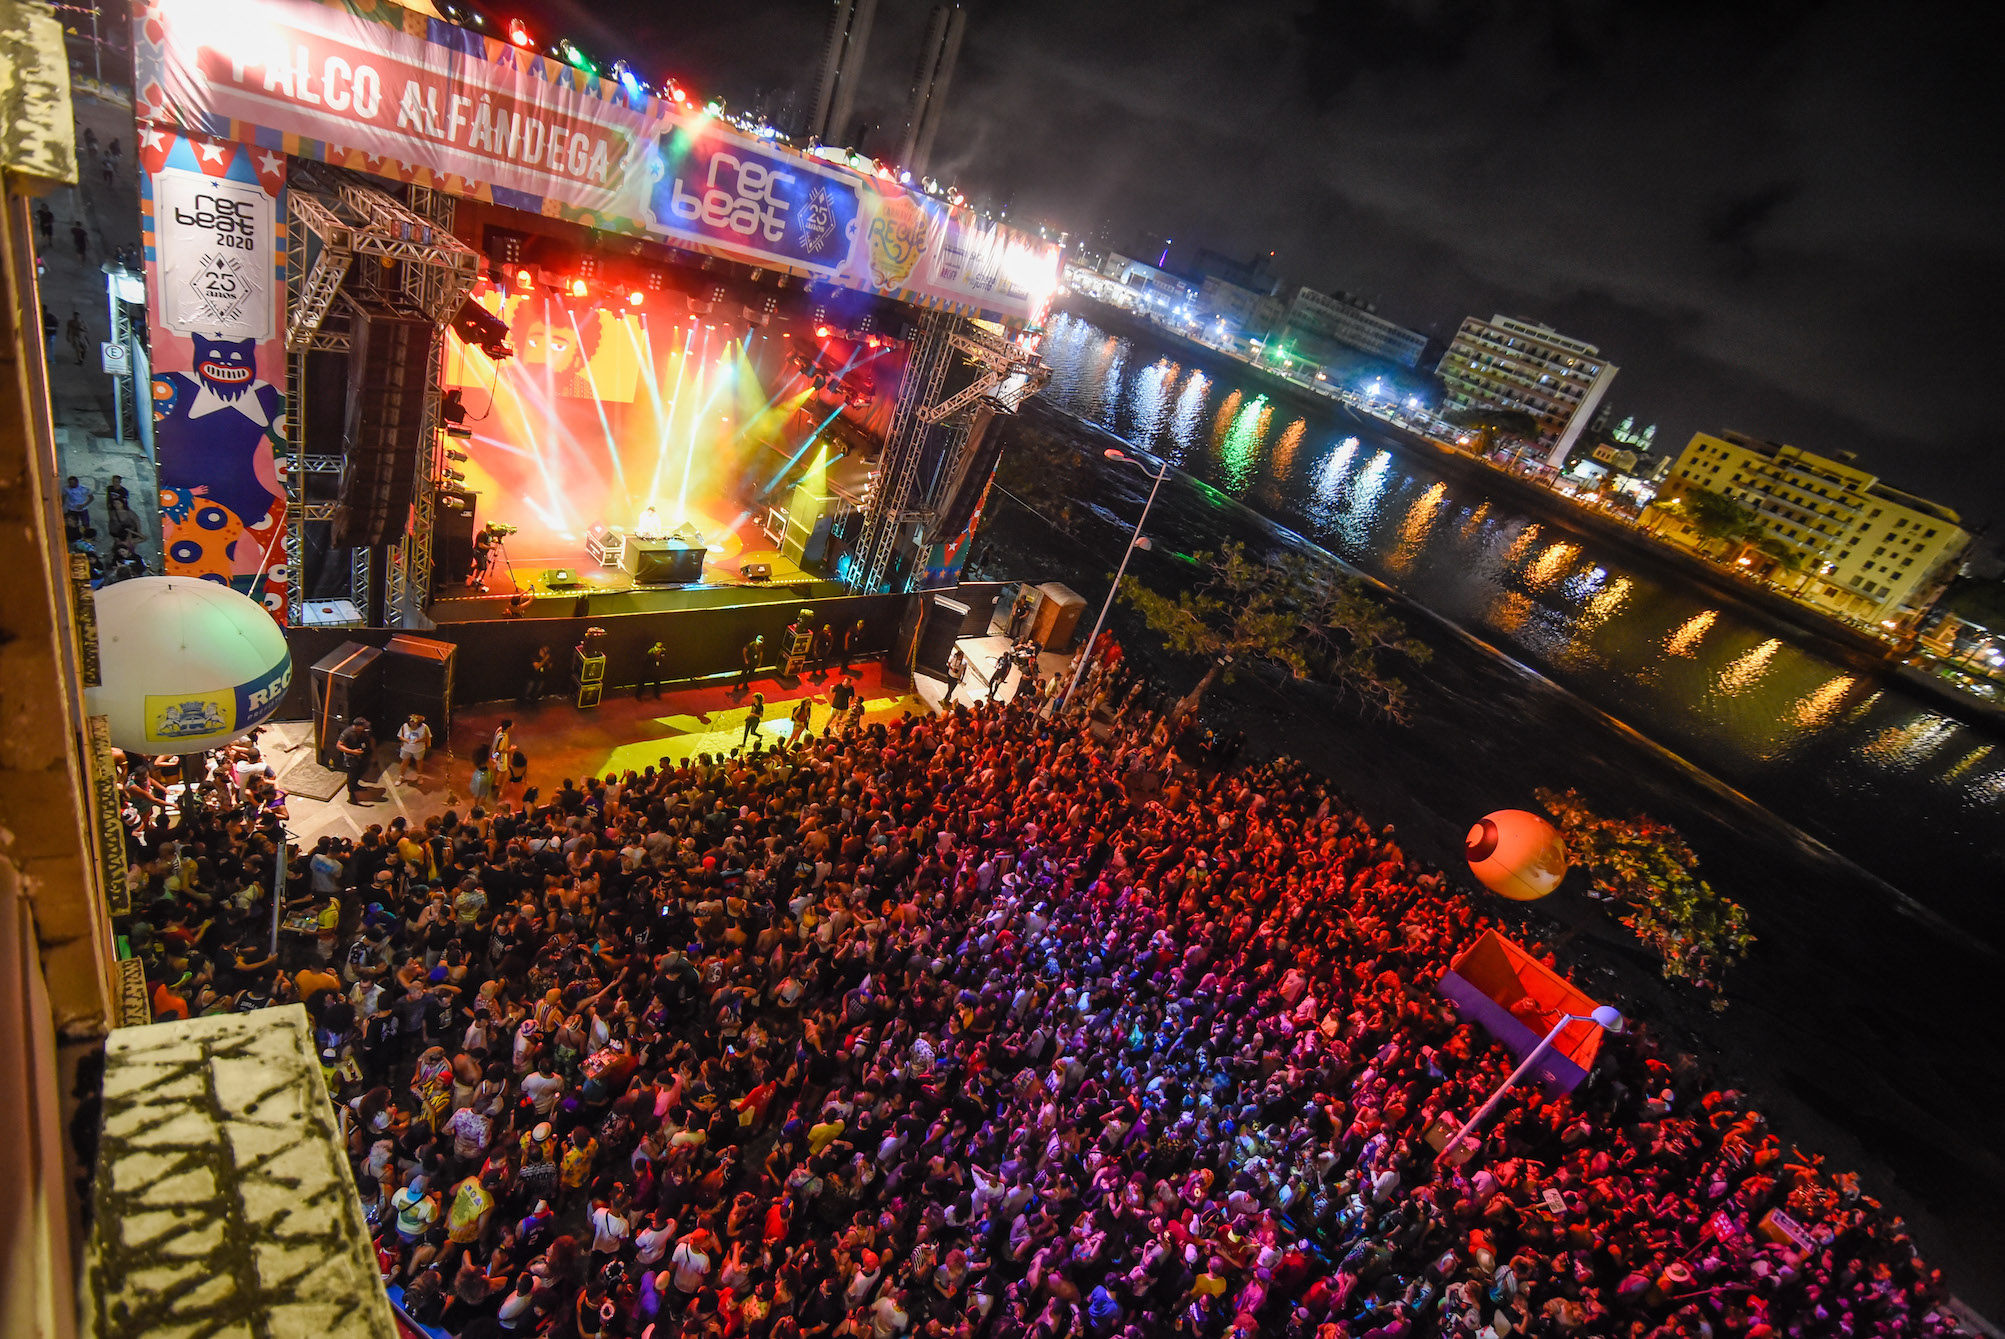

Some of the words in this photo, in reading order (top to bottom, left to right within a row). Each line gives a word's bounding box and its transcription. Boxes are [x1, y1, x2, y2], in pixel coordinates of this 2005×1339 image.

[396, 80, 609, 183] ALFÂNDEGA
[706, 152, 796, 211] rec
[195, 194, 254, 220] rec
[671, 178, 786, 242] beat
[806, 204, 828, 226] 25
[175, 207, 254, 236] beat
[805, 221, 826, 233] anos
[216, 233, 254, 251] 2020
[205, 271, 237, 292] 25
[205, 291, 237, 301] anos
